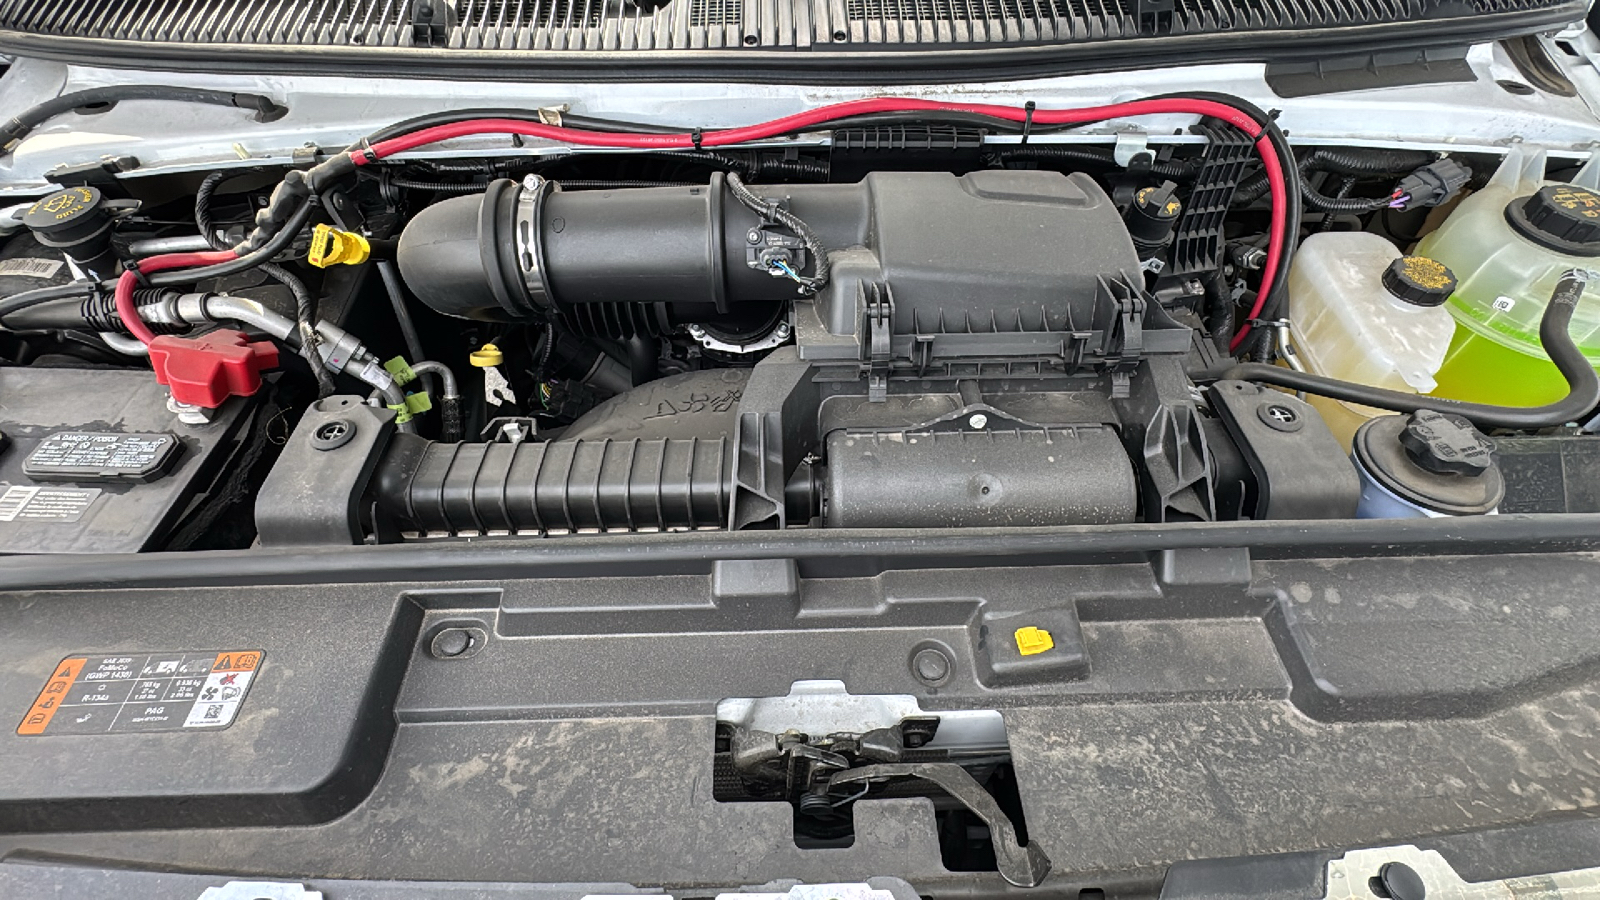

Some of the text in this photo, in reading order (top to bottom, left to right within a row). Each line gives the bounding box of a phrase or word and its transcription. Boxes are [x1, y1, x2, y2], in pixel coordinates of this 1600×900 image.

[55, 204, 83, 219] FLUID
[85, 671, 110, 681] (GWP
[81, 694, 109, 702] R-134a
[144, 706, 165, 714] PAG
